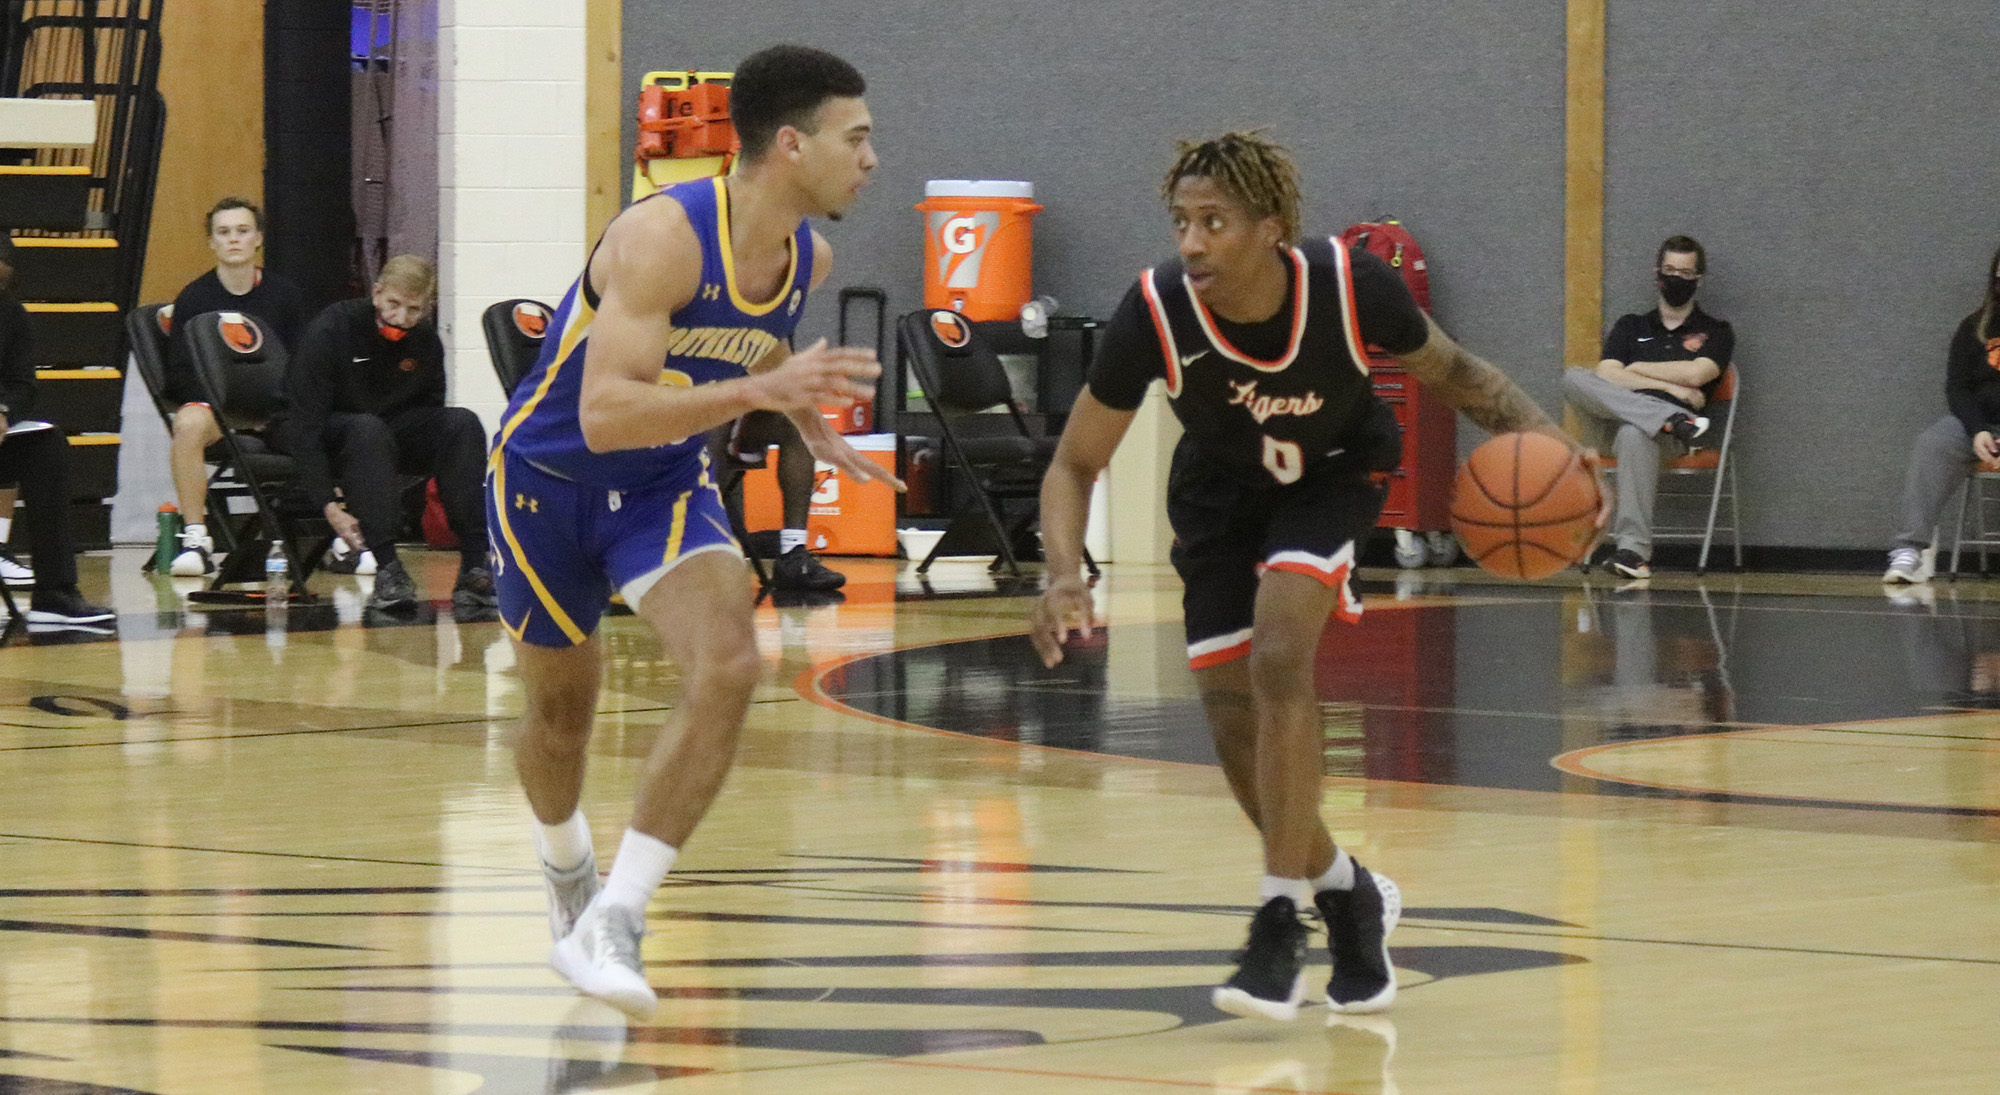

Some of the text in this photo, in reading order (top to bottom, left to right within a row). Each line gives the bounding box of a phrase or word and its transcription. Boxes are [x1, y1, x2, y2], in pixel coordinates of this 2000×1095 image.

[943, 217, 976, 253] G
[1229, 380, 1324, 425] Tigers
[1262, 434, 1304, 485] 0
